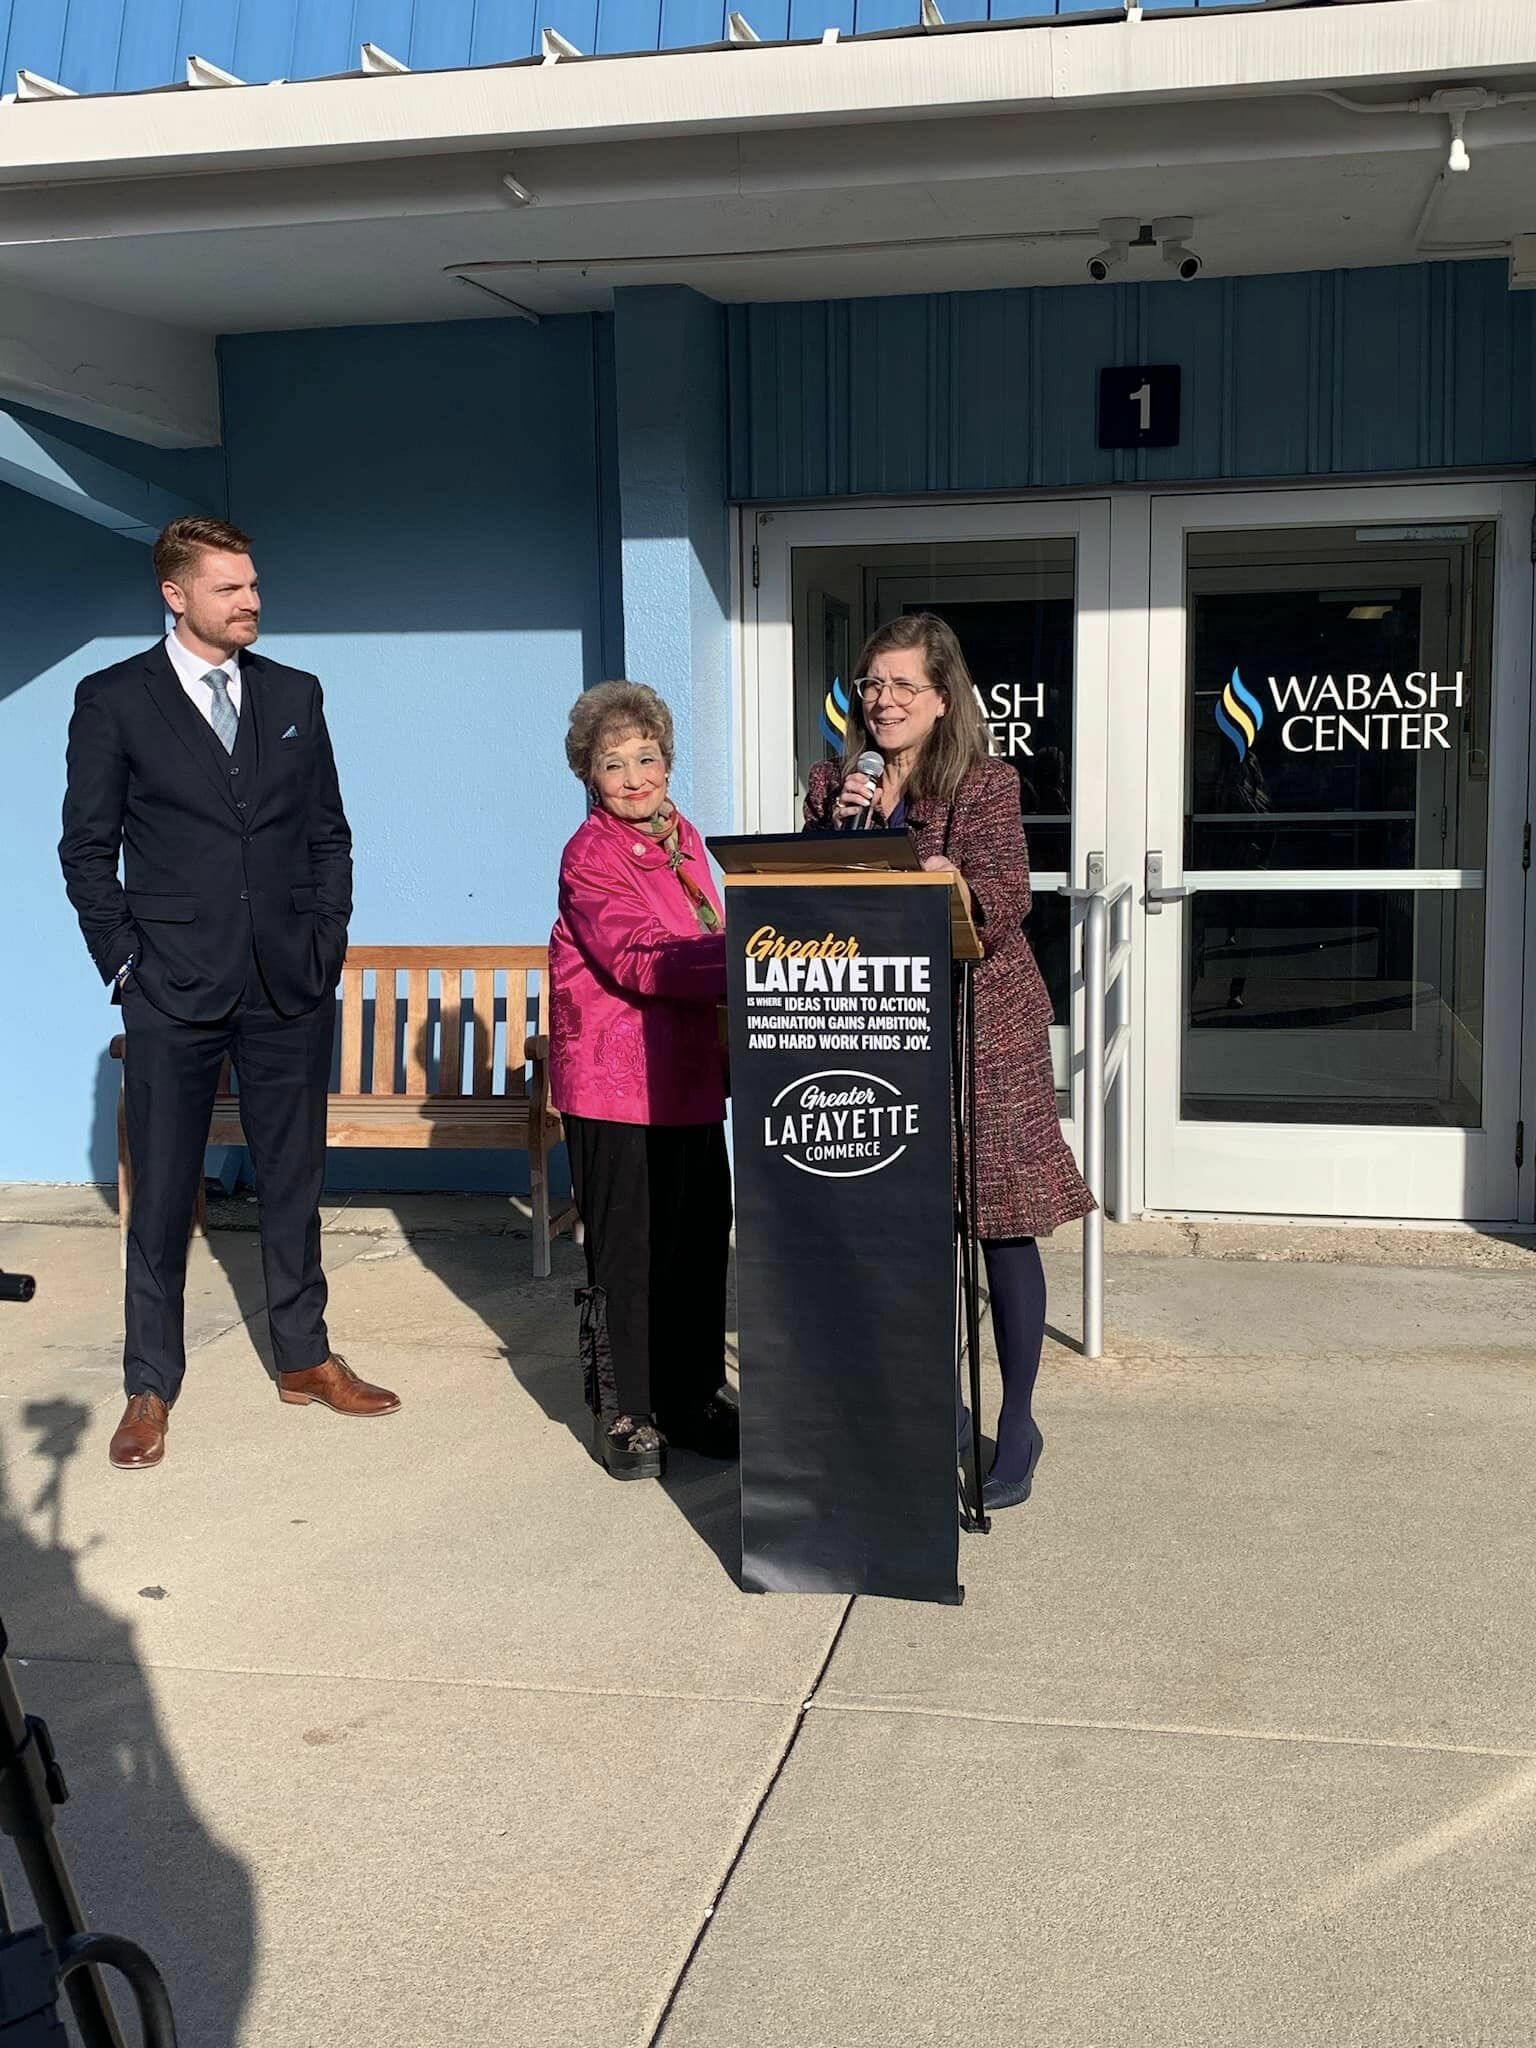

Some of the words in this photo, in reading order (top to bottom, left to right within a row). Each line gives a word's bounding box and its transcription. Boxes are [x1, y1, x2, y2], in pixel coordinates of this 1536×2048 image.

[1129, 384, 1151, 429] 1
[1267, 671, 1464, 712] WABASH
[1281, 713, 1451, 752] CENTER
[745, 925, 860, 961] Greater
[745, 956, 931, 992] LAFAYETTE
[747, 997, 755, 1007] IS
[756, 997, 782, 1007] WHERE
[784, 997, 821, 1011] IDEAS
[823, 997, 858, 1012] TURN
[859, 997, 878, 1012] TO
[879, 997, 930, 1014] ACTION,
[747, 1015, 826, 1030] IMAGINATION
[827, 1016, 865, 1030] GAINS
[867, 1016, 931, 1032] AMBITION,
[748, 1034, 777, 1049] AND
[779, 1034, 817, 1049] HARD
[818, 1034, 859, 1050] WORK
[861, 1034, 901, 1050] FINDS
[903, 1035, 931, 1050] JOY.
[799, 1085, 876, 1110] Greater
[764, 1104, 919, 1146] LAFAYETTE
[805, 1141, 881, 1161] COMMERCE
